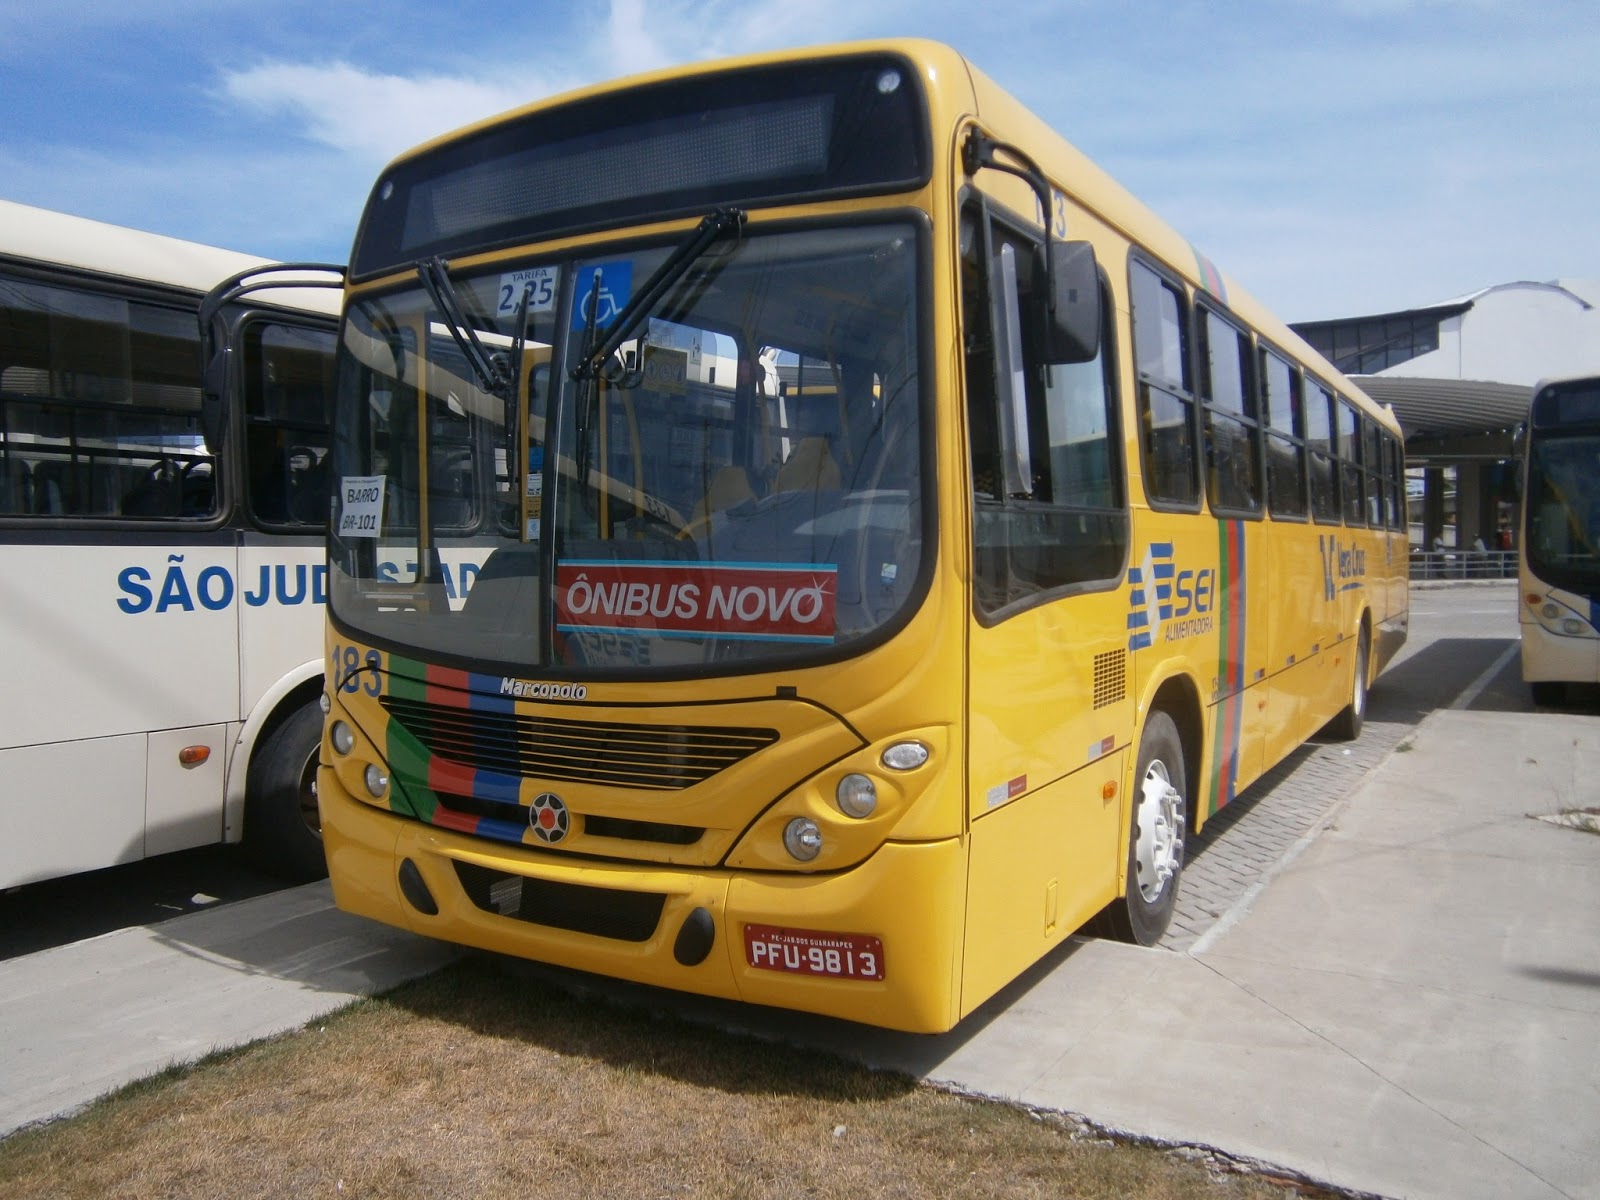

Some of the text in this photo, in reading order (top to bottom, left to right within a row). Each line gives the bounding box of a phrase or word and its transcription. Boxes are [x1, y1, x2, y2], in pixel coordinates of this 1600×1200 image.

[512, 269, 547, 282] TARIFA
[499, 277, 553, 314] 2,25
[347, 487, 379, 503] BARRO
[342, 514, 376, 530] BR-101
[116, 554, 234, 614] SÃO
[1174, 569, 1216, 617] SEI
[567, 573, 823, 624] ÔNIBUS NOVO
[1165, 615, 1214, 643] ALIMENTADORA
[332, 645, 382, 697] 183
[500, 677, 587, 700] Marcopolo
[809, 938, 853, 949] GUARARAPES
